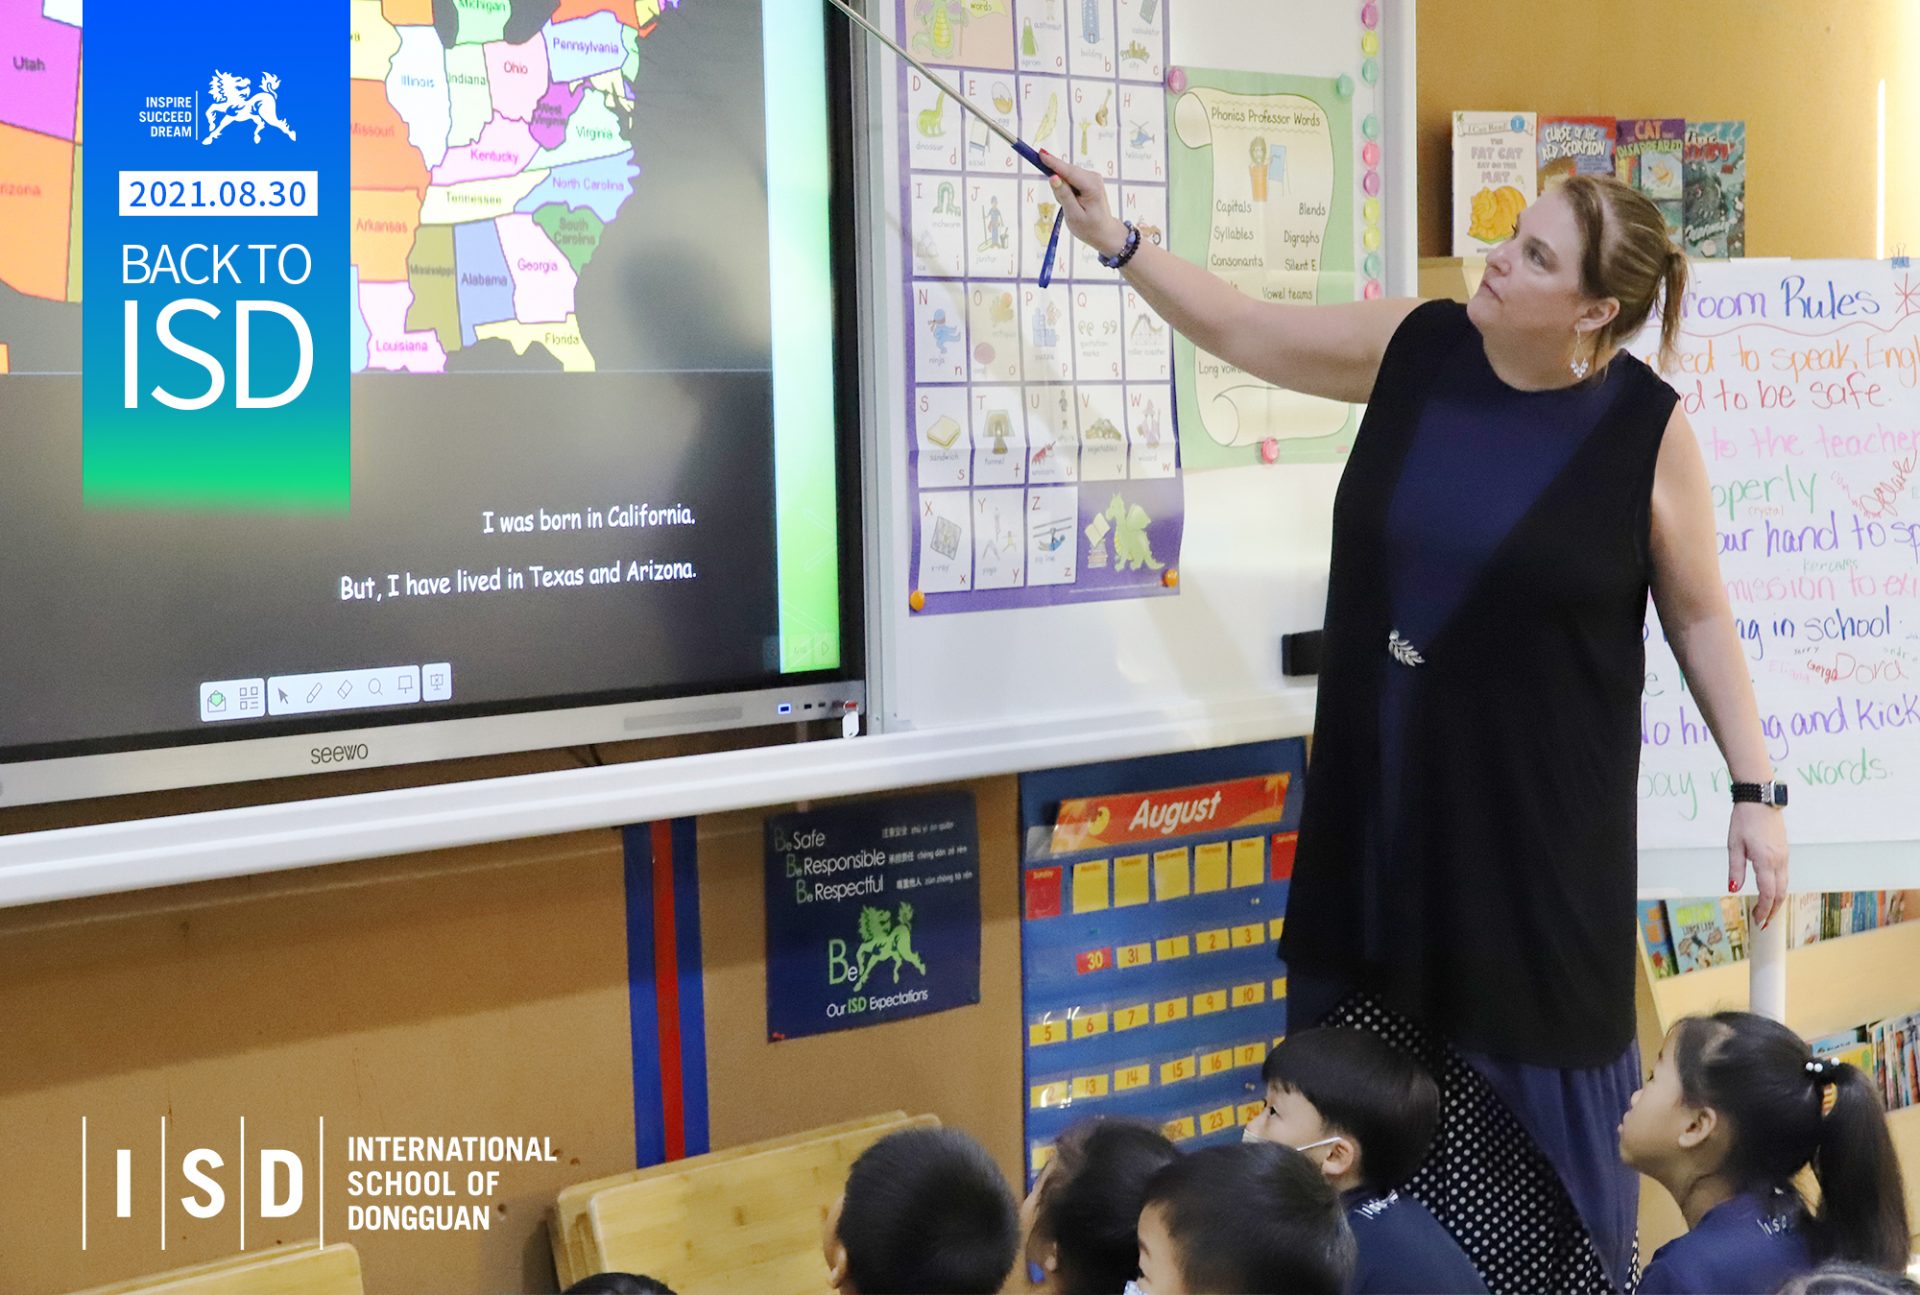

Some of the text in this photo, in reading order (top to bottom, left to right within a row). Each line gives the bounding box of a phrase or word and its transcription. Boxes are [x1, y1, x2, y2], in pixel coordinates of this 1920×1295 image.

[553, 37, 620, 55] Pennsylvania
[13, 56, 45, 72] Utah
[503, 60, 529, 75] Ohio
[1105, 57, 1111, 72] b
[400, 74, 436, 88] Illinois
[447, 72, 487, 87] Indiana
[913, 75, 921, 91] D
[969, 80, 976, 96] E
[1025, 83, 1032, 99] F
[1075, 88, 1082, 103] G
[1124, 93, 1131, 108] H
[1211, 107, 1320, 127] Phonics Professor Words
[575, 126, 613, 141] Virginia
[1545, 125, 1572, 142] CURSE
[1584, 127, 1598, 140] THE
[1635, 121, 1662, 140] CAT
[470, 149, 519, 165] Kentucky
[949, 147, 957, 165] d
[1471, 146, 1523, 160] FAT CAT
[1542, 139, 1607, 161] RED SCORPION
[1616, 140, 1684, 158] DISAPPEARED
[1005, 156, 1013, 167] e
[552, 177, 625, 192] North Carolina
[1481, 171, 1511, 184] MAT
[0, 183, 42, 197] rizona
[971, 187, 980, 202] J
[1027, 187, 1034, 203] K
[446, 192, 502, 205] Tennessee
[1127, 194, 1135, 208] M
[1216, 200, 1252, 216] Capitals
[1299, 203, 1326, 217] Blends
[355, 217, 408, 234] Arkansas
[559, 217, 589, 231] South
[554, 232, 596, 246] Carolina
[1214, 226, 1254, 242] Syllables
[1283, 230, 1319, 247] Digraphs
[517, 256, 558, 273] Georgia
[1211, 253, 1263, 268] Consonants
[1284, 256, 1317, 272] Silent E
[461, 272, 508, 287] Alabama
[918, 289, 928, 305] N
[973, 290, 982, 306] O
[1025, 293, 1033, 306] P
[1077, 293, 1087, 307] Q
[1128, 293, 1136, 308] R
[1262, 286, 1312, 300] Vowel teams
[1781, 275, 1880, 320] Rules
[375, 340, 429, 353] Louisiana
[545, 333, 580, 347] Florida
[1731, 335, 1760, 372] to
[1771, 339, 1857, 383] speak
[954, 366, 962, 376] n
[1198, 361, 1219, 378] Long
[920, 395, 929, 412] S
[976, 395, 986, 410] T
[1031, 395, 1040, 409] U
[1082, 395, 1090, 408] V
[1130, 393, 1142, 407] W
[1714, 379, 1748, 412] to
[1757, 380, 1796, 409] be
[1709, 426, 1738, 461] to
[1750, 425, 1804, 459] the
[1711, 464, 1817, 521] operly
[924, 502, 933, 517] X
[978, 498, 985, 513] Y
[1032, 496, 1041, 511] Z
[483, 503, 696, 533] I was born in California.
[1765, 510, 1838, 557] hand
[1851, 514, 1886, 550] to
[340, 559, 697, 602] But, I have lived in Texas and Arizona.
[1850, 566, 1876, 597] to
[1883, 571, 1920, 599] exi
[1773, 613, 1795, 639] in
[1791, 696, 1849, 737] and
[310, 742, 369, 765] seewo
[1128, 790, 1222, 835] August
[774, 828, 826, 851] Be Safe
[786, 853, 802, 878] Be
[804, 849, 886, 880] Responsible
[796, 879, 813, 904] Be
[815, 874, 884, 901] Respectful
[1087, 951, 1104, 970] 30
[1128, 948, 1139, 964] 31
[1209, 934, 1216, 949] 2
[1245, 929, 1251, 943] 3
[828, 938, 858, 985] Be
[826, 988, 928, 1018] Our ISD Expectations
[1044, 988, 1254, 1041] 5 6 7 8 9 10
[1085, 1047, 1254, 1094] 13 14 15 16 17
[1210, 1112, 1223, 1129] 23
